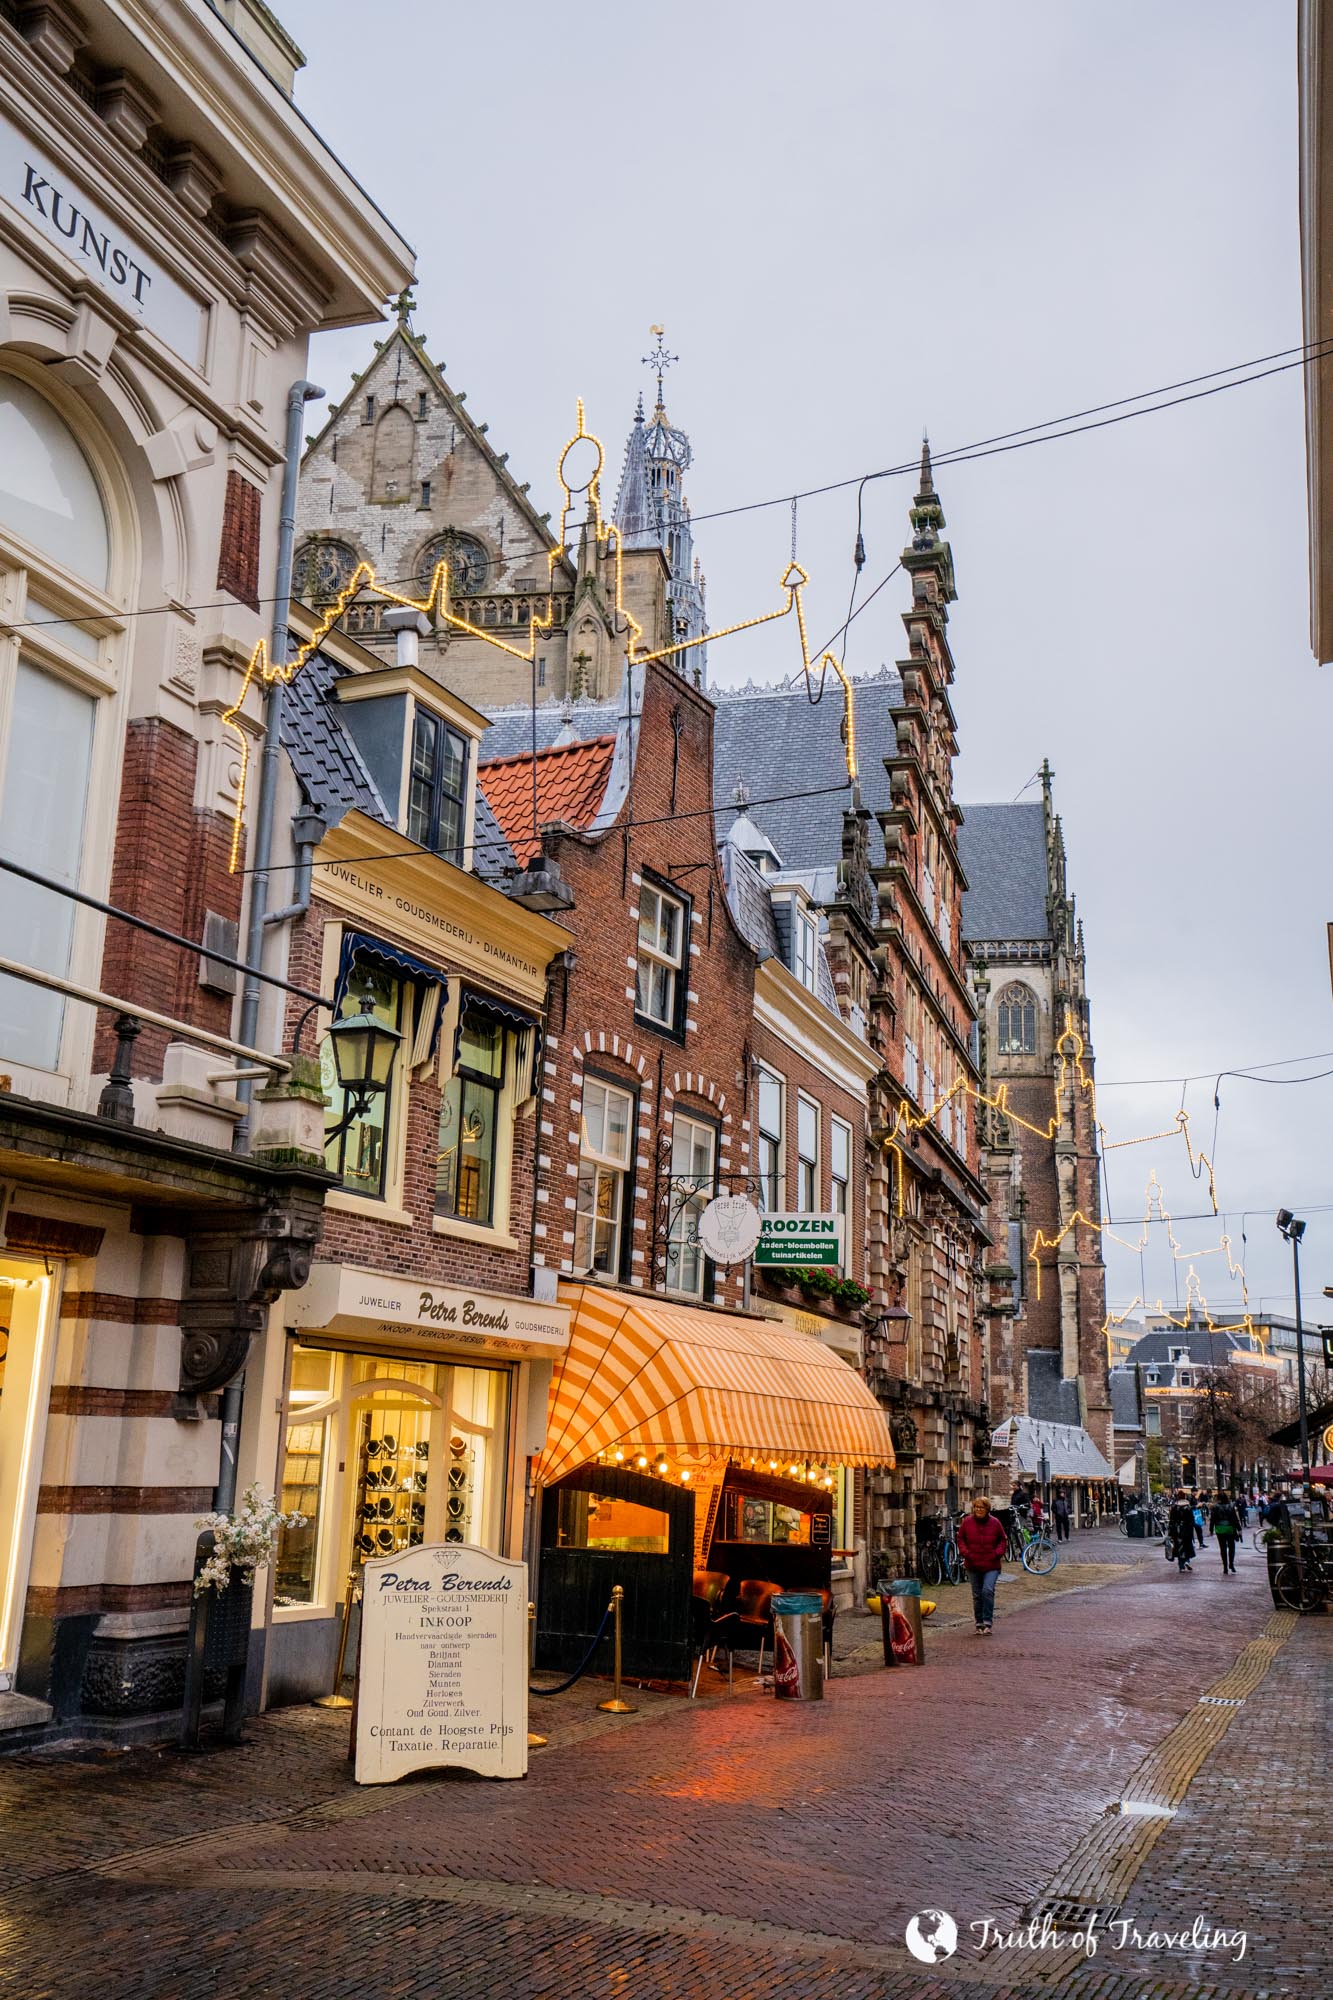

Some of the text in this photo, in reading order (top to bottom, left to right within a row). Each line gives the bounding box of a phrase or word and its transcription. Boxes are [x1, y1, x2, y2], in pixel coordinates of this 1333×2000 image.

[21, 162, 151, 306] KUNST
[323, 863, 383, 900] JUWELIER
[395, 897, 474, 945] GOUDSMEDERIJ
[484, 942, 538, 978] DIAMANTAIR
[762, 1220, 834, 1233] ROOZEN
[761, 1242, 834, 1250] zaden-bloembollen
[359, 1292, 565, 1336] JUWELIER Petra Berends GOUDSMEDERIJ
[794, 1314, 822, 1336] ROOZEN
[377, 1323, 532, 1352] INKOOP VERKOOP DESIGN REPARATIE
[379, 1573, 512, 1592] Petra Berends
[421, 1605, 462, 1613] Spekstraat
[420, 1617, 472, 1628] INKOOP
[395, 1632, 463, 1641] Handvervaardigde
[441, 1642, 470, 1651] ontwerp
[430, 1651, 460, 1659] Briljant
[428, 1660, 462, 1669] Diamant
[429, 1680, 461, 1688] Munten
[426, 1689, 463, 1698] Horloges
[423, 1699, 465, 1708] Zilverwerk
[406, 1709, 424, 1718] Oud
[370, 1723, 514, 1737] Contant de Hoogste Prijs
